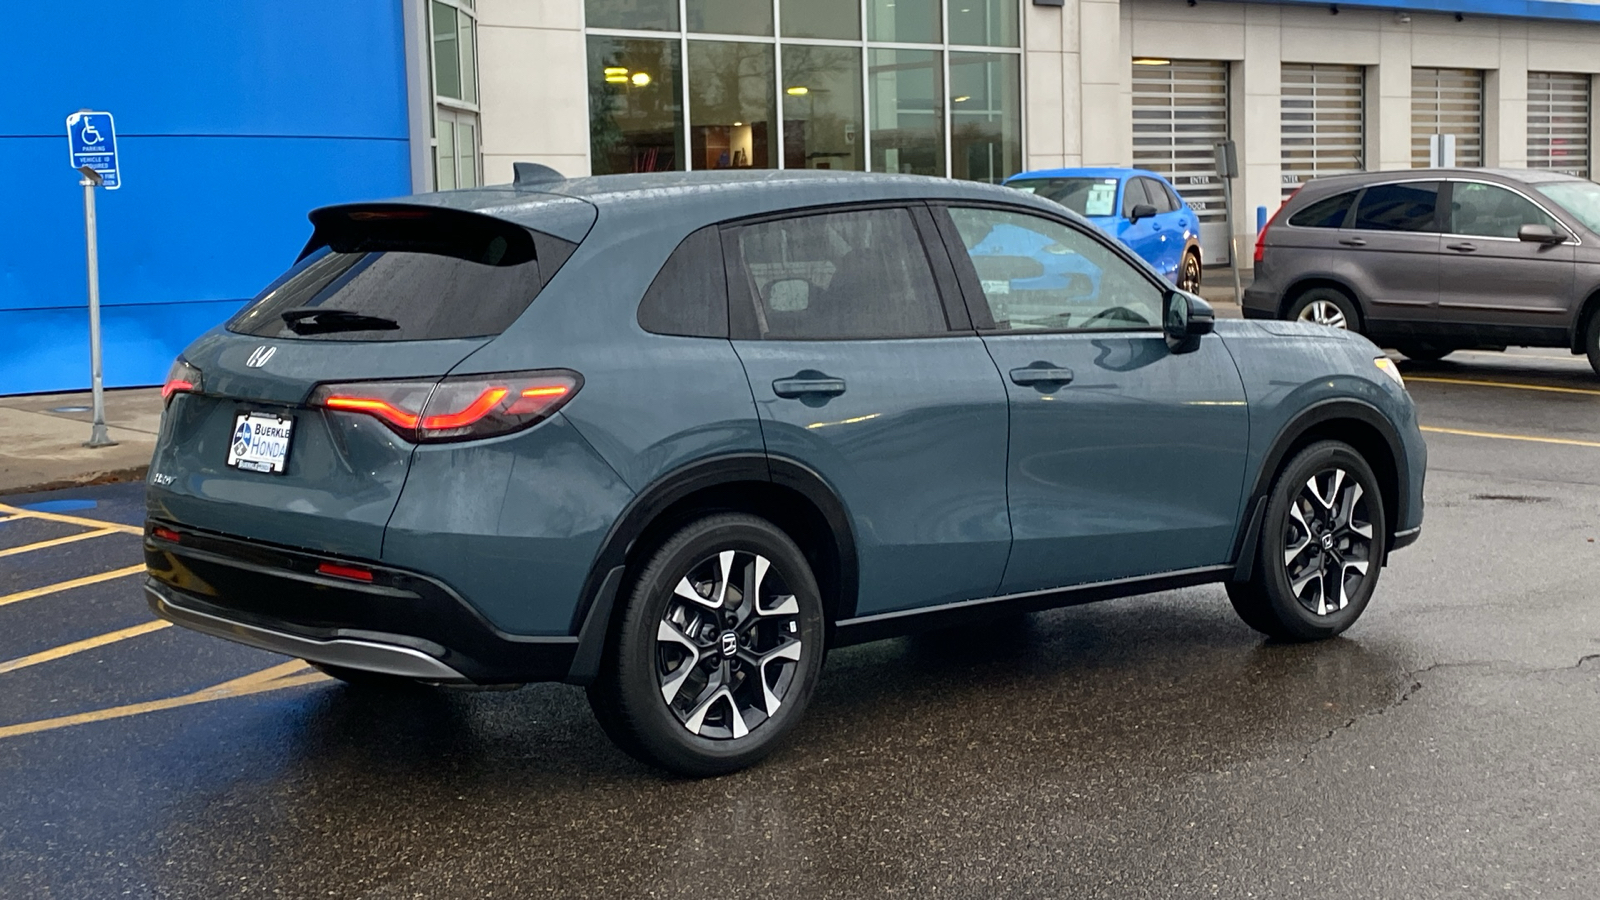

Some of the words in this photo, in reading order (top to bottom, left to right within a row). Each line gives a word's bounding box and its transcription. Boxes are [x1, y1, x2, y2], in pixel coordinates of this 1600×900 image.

[1190, 176, 1209, 184] ENTER
[254, 423, 290, 439] BUERKLE
[250, 436, 287, 458] HONDA
